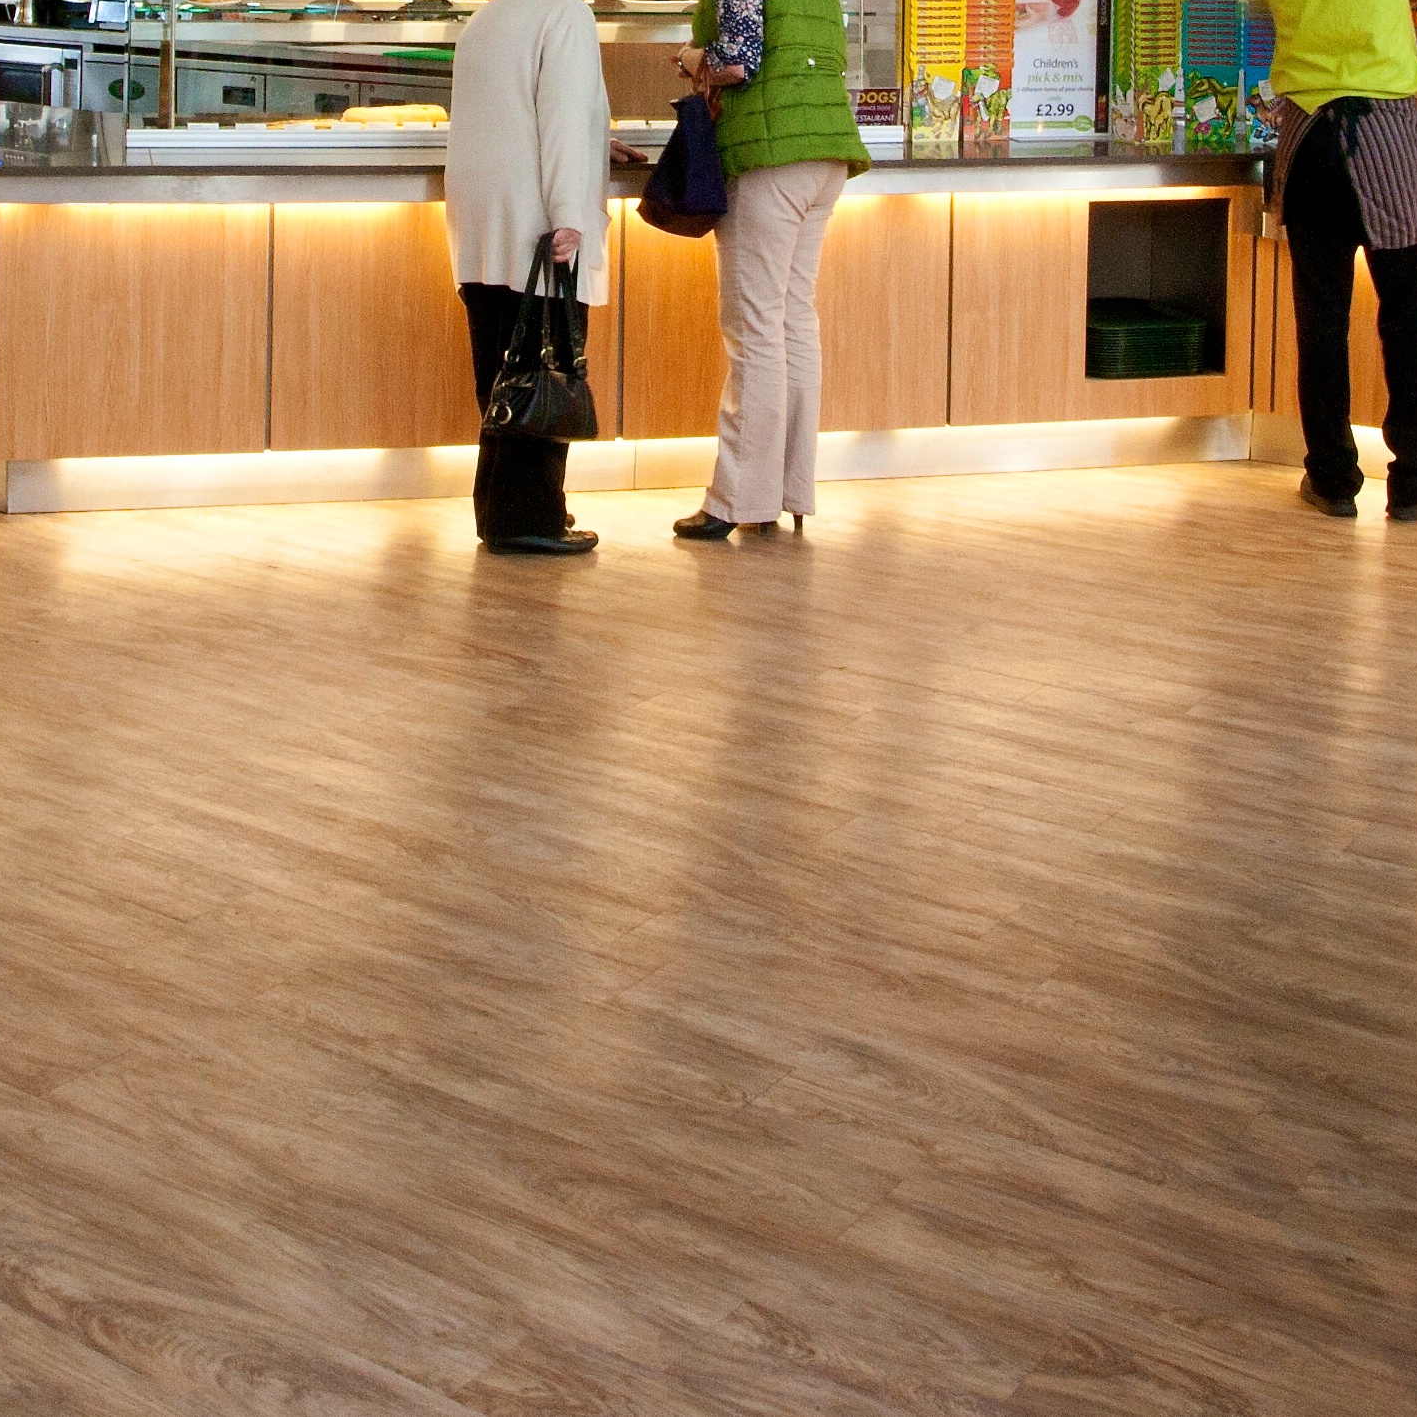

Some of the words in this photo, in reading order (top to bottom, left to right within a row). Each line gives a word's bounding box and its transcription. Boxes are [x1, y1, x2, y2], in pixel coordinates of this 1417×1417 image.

[1033, 58, 1079, 69] Children's
[1027, 72, 1050, 84] pick
[1052, 72, 1060, 82] &
[1063, 72, 1084, 82] mix
[857, 91, 897, 103] DOGS
[1036, 103, 1074, 116] £2.99
